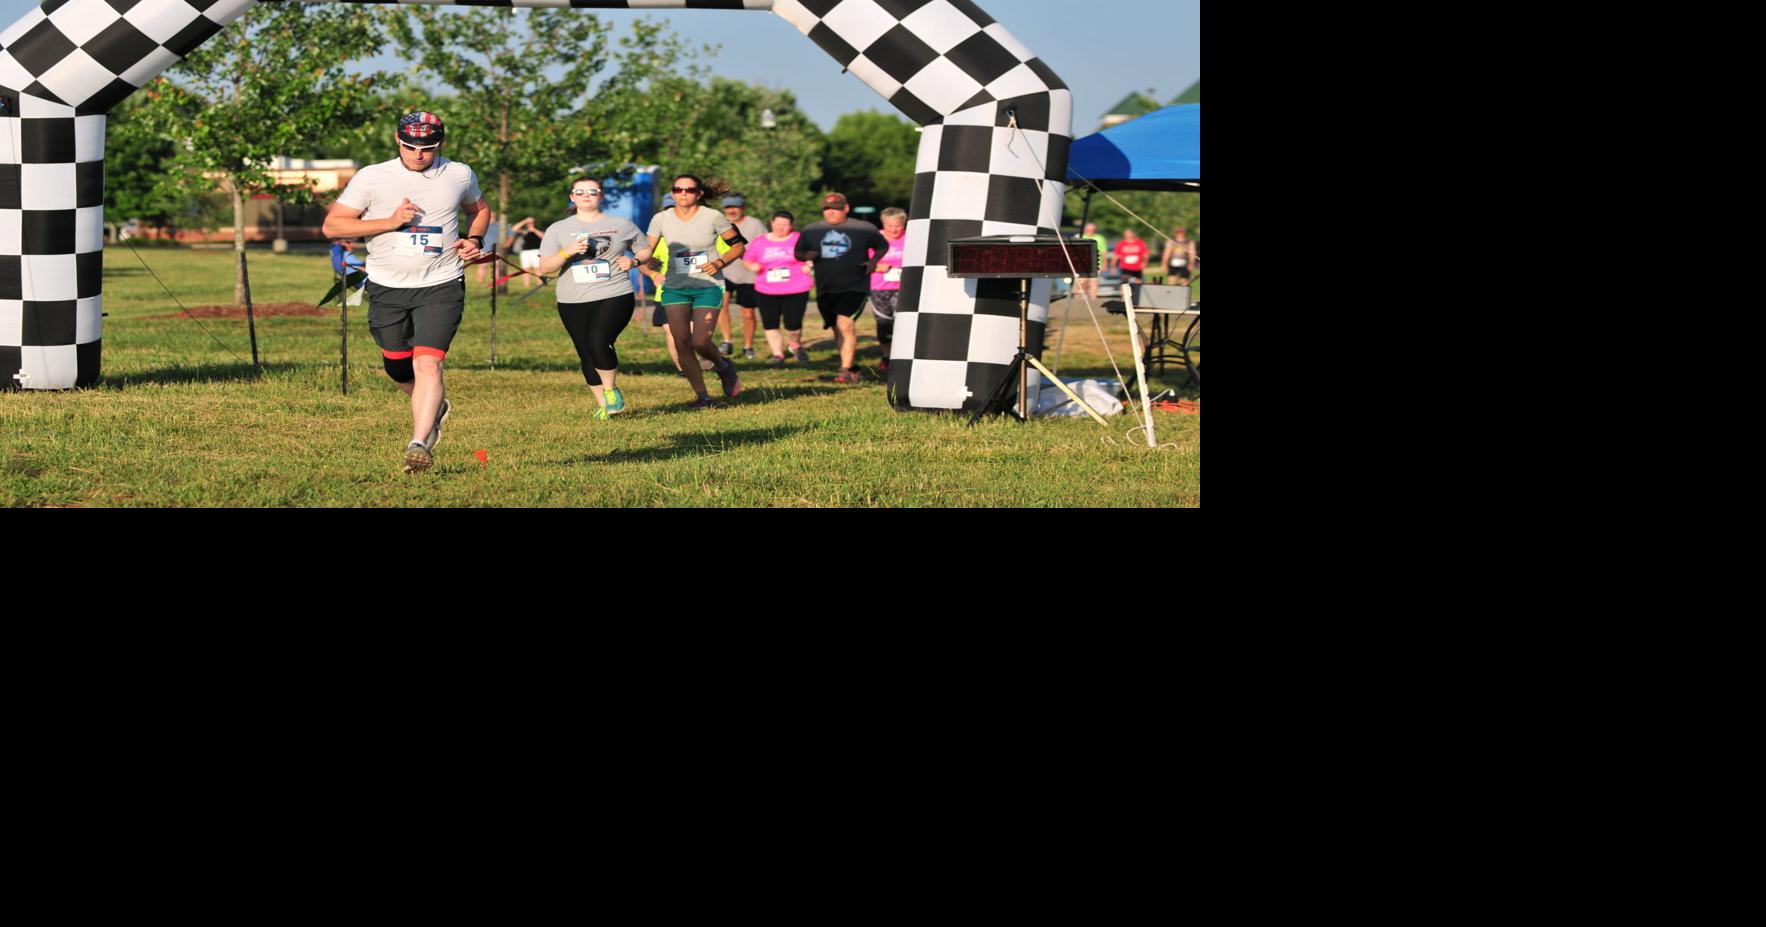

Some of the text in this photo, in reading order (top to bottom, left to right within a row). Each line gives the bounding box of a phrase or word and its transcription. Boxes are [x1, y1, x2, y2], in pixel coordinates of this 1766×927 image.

[410, 234, 429, 245] 15
[684, 257, 697, 266] 50
[584, 265, 598, 274] 10
